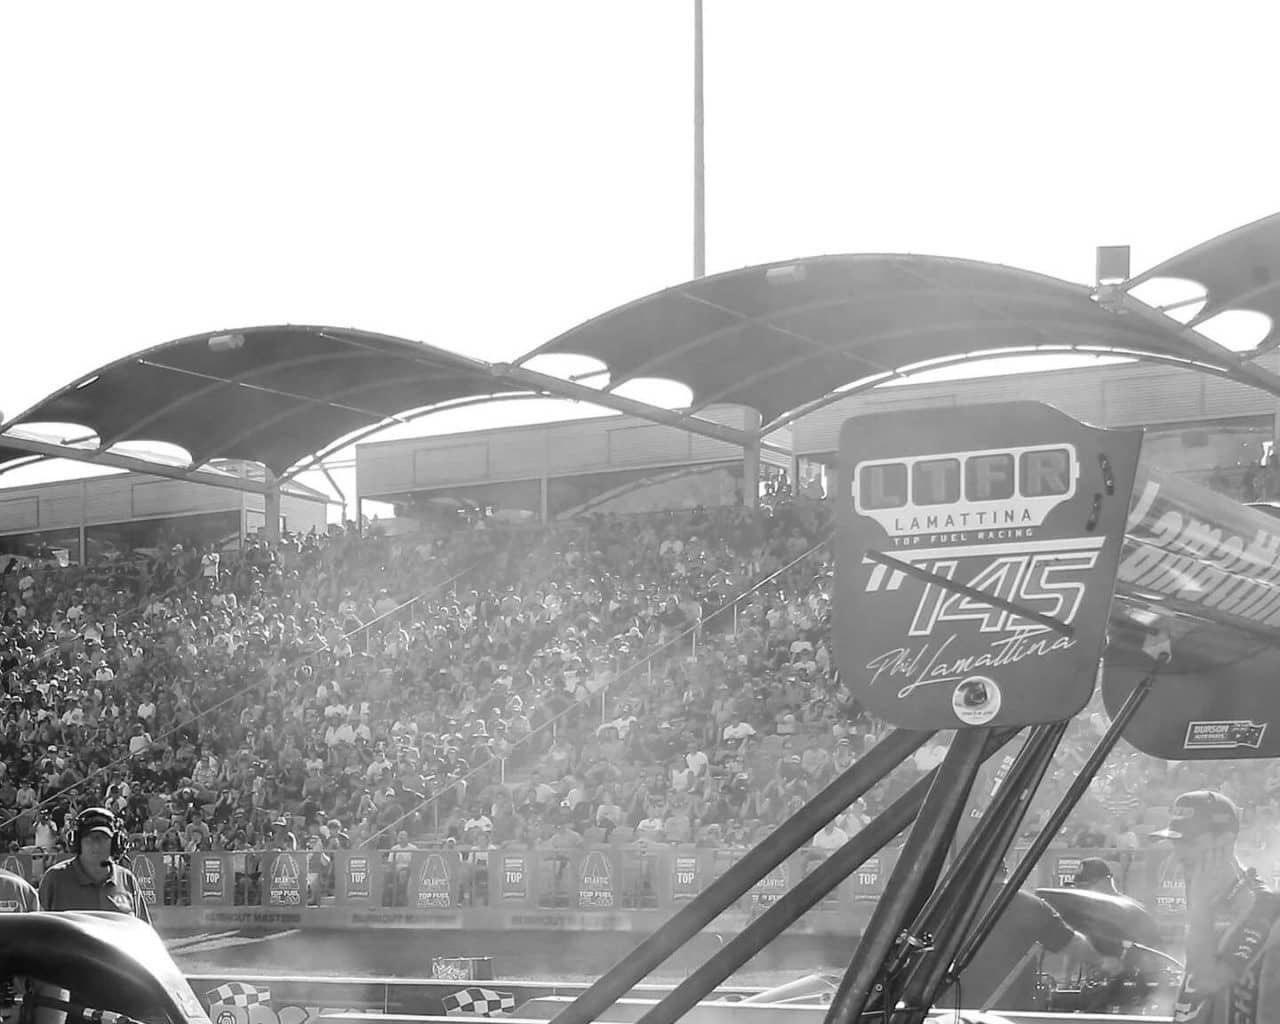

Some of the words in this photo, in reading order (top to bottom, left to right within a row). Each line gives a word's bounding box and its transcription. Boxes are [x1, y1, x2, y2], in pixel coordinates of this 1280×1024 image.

[894, 508, 1033, 531] LAMATTINA
[893, 536, 920, 546] TOP
[931, 532, 968, 544] FUEL
[978, 527, 1033, 540] RACING
[866, 644, 929, 687] Phil
[897, 629, 1078, 698] Lamattina
